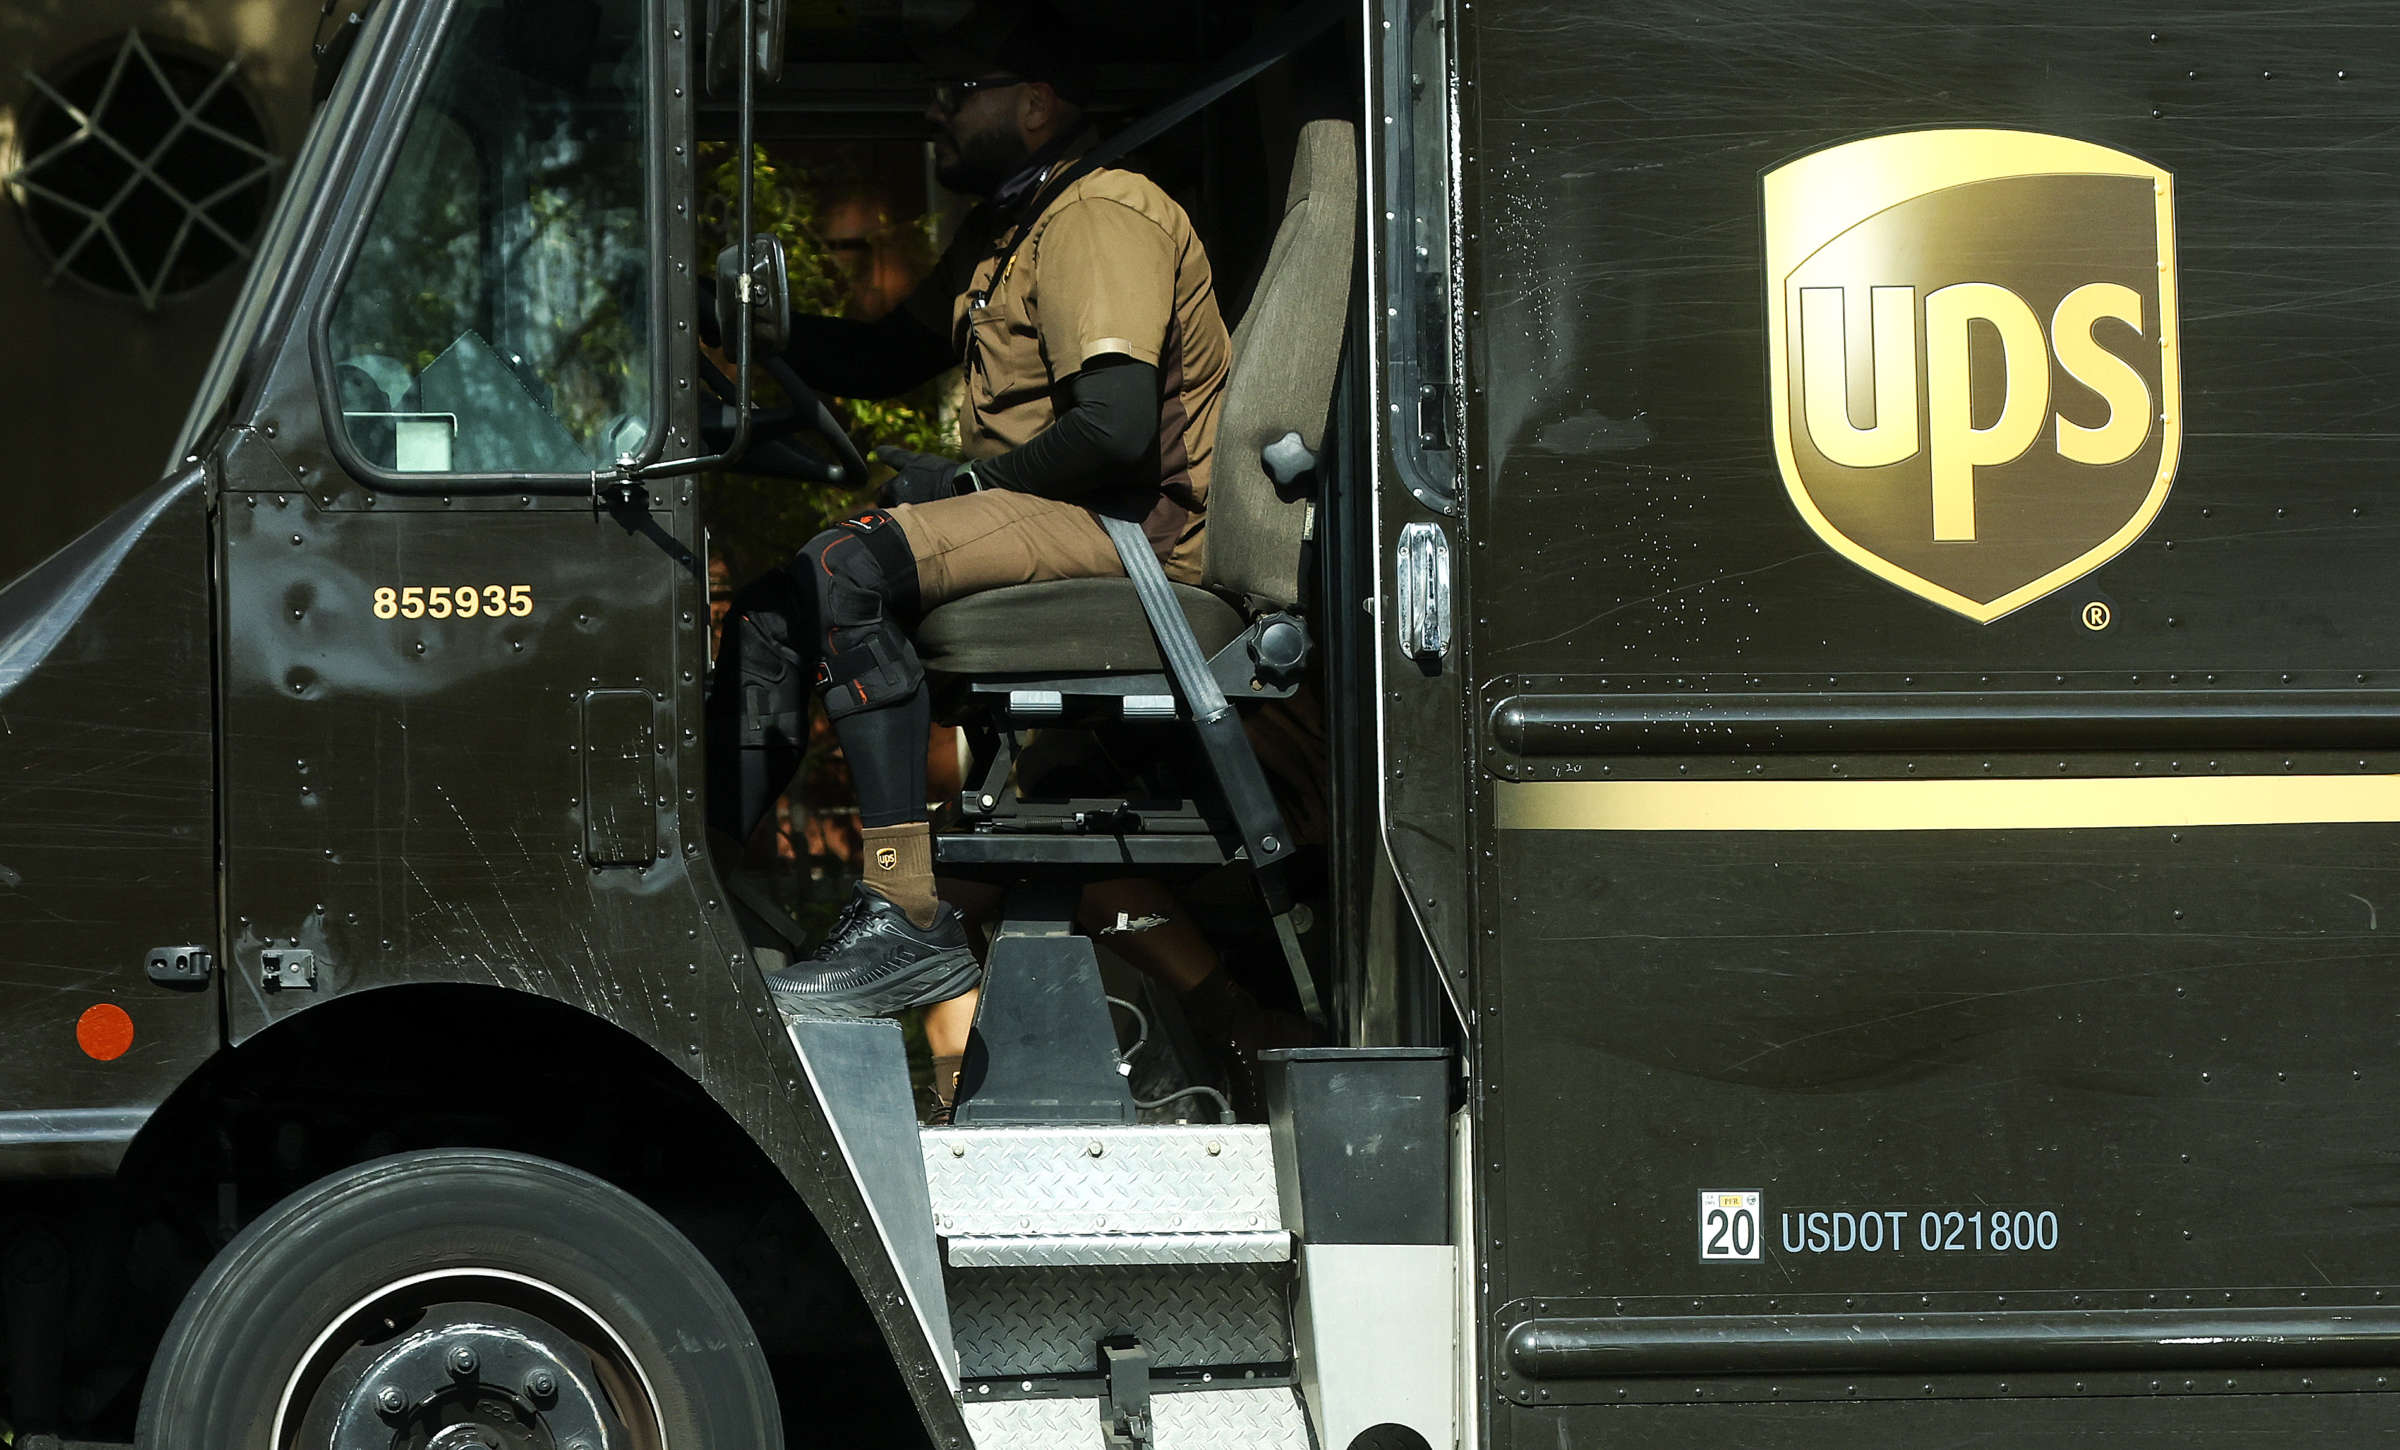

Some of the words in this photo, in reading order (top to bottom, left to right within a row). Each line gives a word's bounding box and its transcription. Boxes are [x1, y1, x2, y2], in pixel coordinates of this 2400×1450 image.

[1800, 281, 2154, 543] ups
[372, 584, 535, 620] 855935
[879, 853, 895, 867] ups
[1707, 1208, 1755, 1256] 20
[1781, 1211, 1908, 1253] USDOT
[1919, 1209, 2060, 1252] 021800
